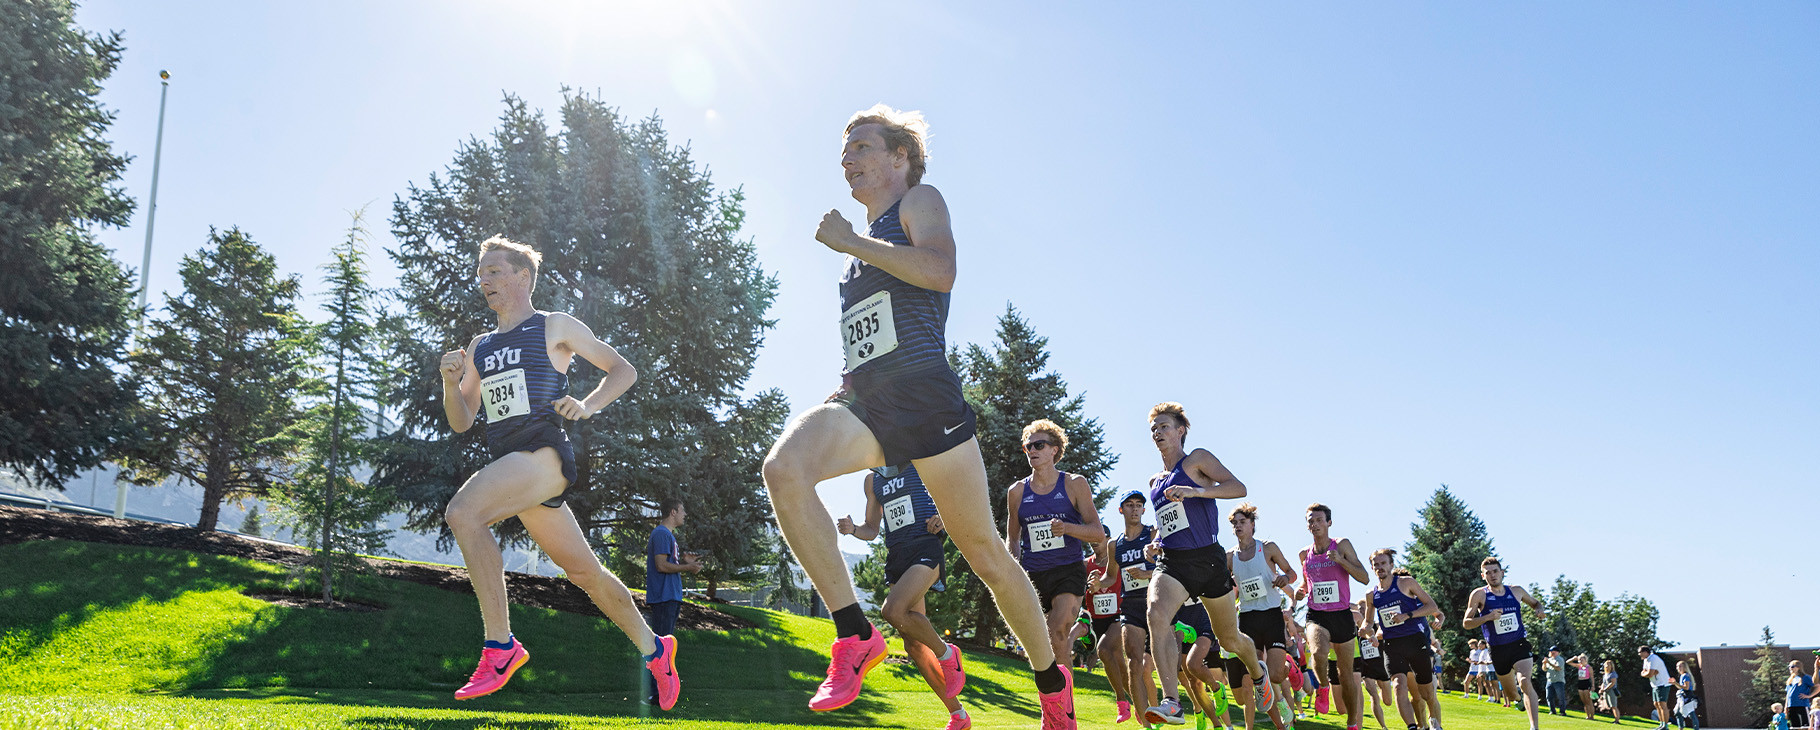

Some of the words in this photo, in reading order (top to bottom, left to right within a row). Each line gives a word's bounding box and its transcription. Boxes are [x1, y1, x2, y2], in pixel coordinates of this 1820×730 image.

[848, 312, 880, 345] 2835
[484, 347, 522, 372] BYU
[489, 383, 515, 405] 2834
[882, 477, 905, 496] BYU
[890, 505, 906, 520] 2830
[1161, 509, 1178, 526] 2908
[1121, 549, 1142, 563] BYU
[1317, 587, 1333, 596] 2890
[1097, 599, 1111, 608] 2837
